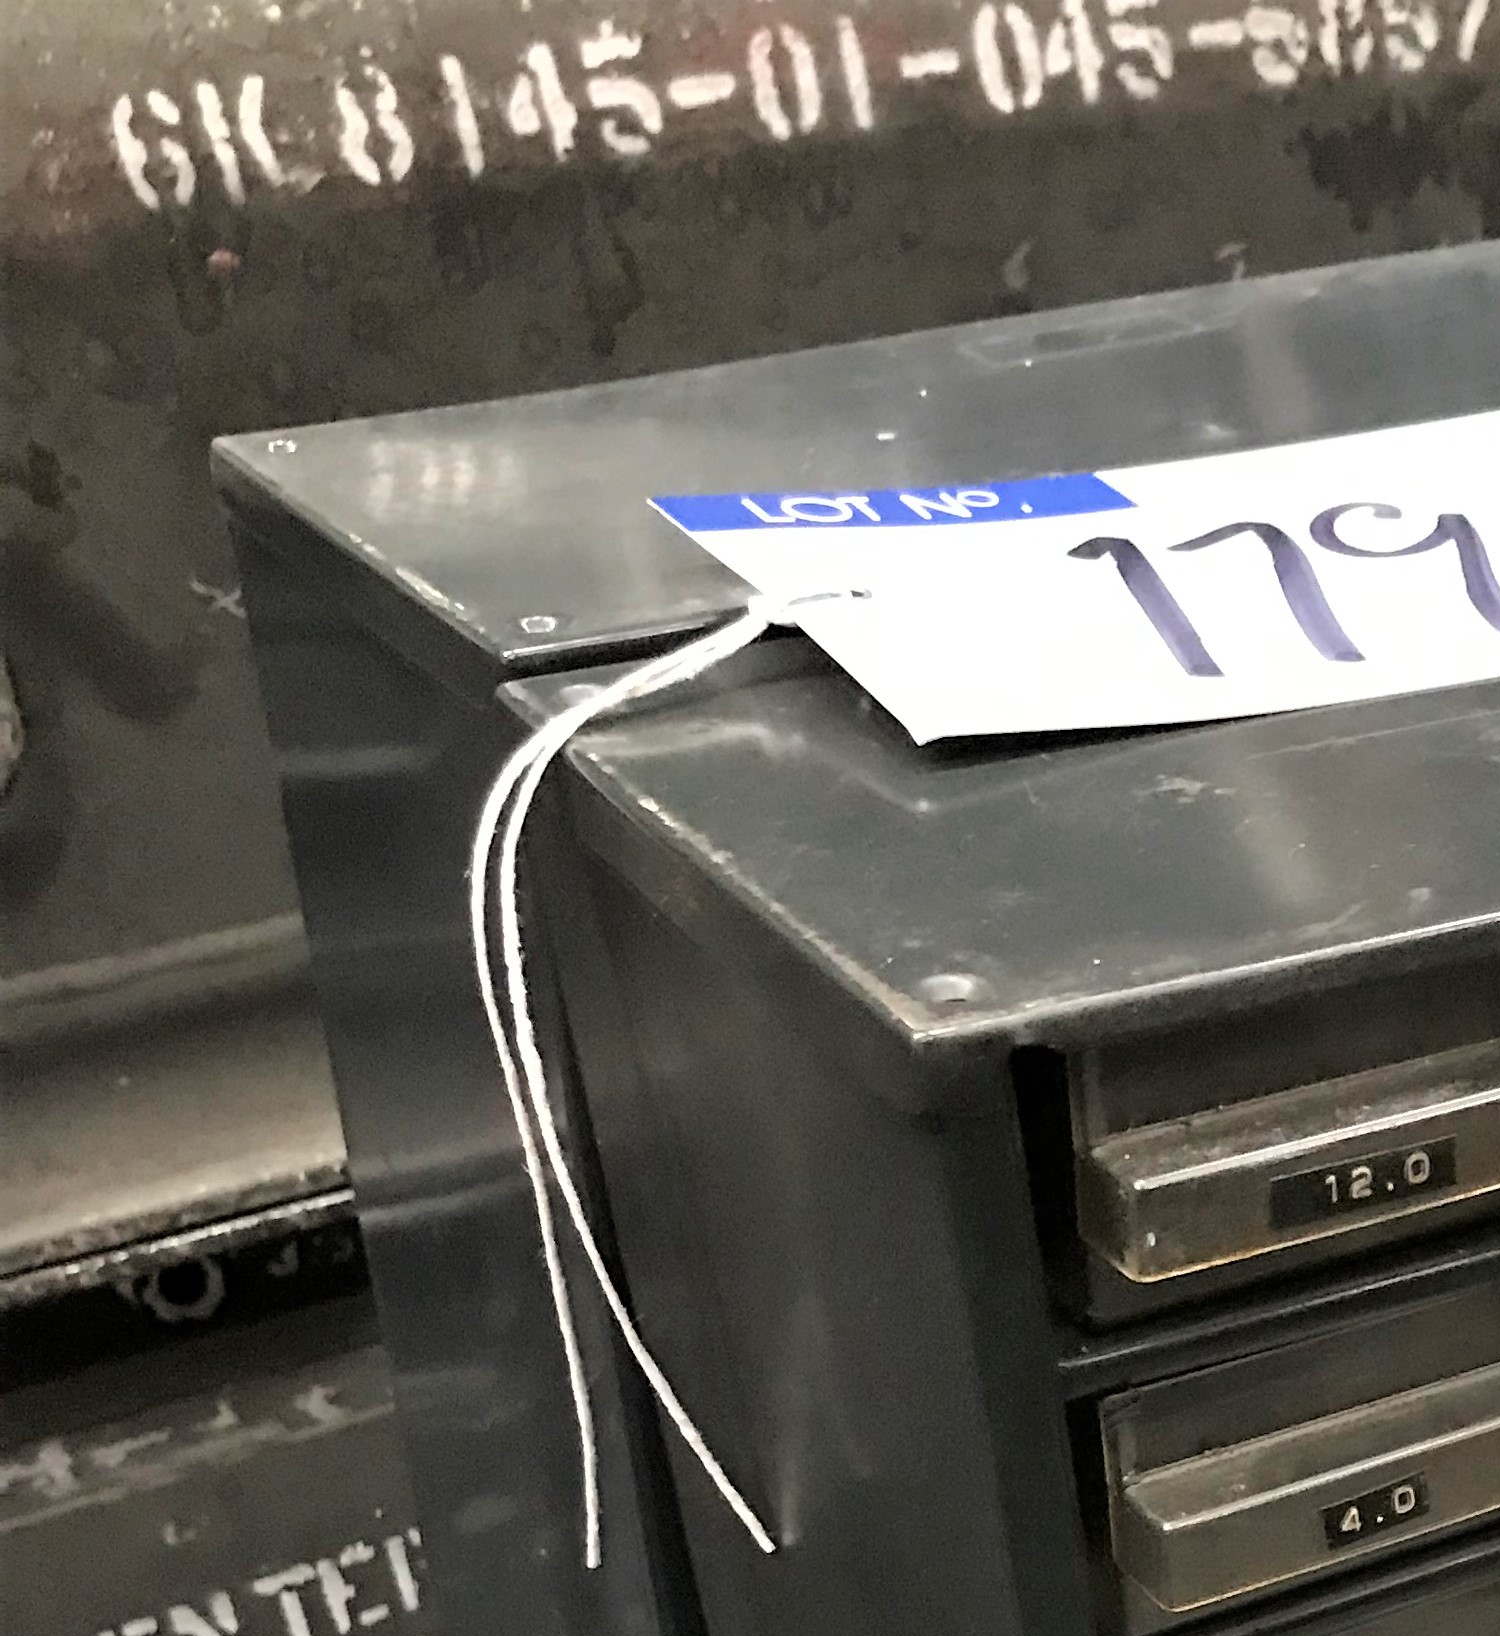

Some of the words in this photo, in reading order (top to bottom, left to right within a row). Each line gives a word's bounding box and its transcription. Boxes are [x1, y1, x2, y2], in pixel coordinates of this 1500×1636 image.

[741, 495, 881, 524] LOT
[1325, 1151, 1431, 1203] 12.0
[1340, 1485, 1415, 1532] 4.0
